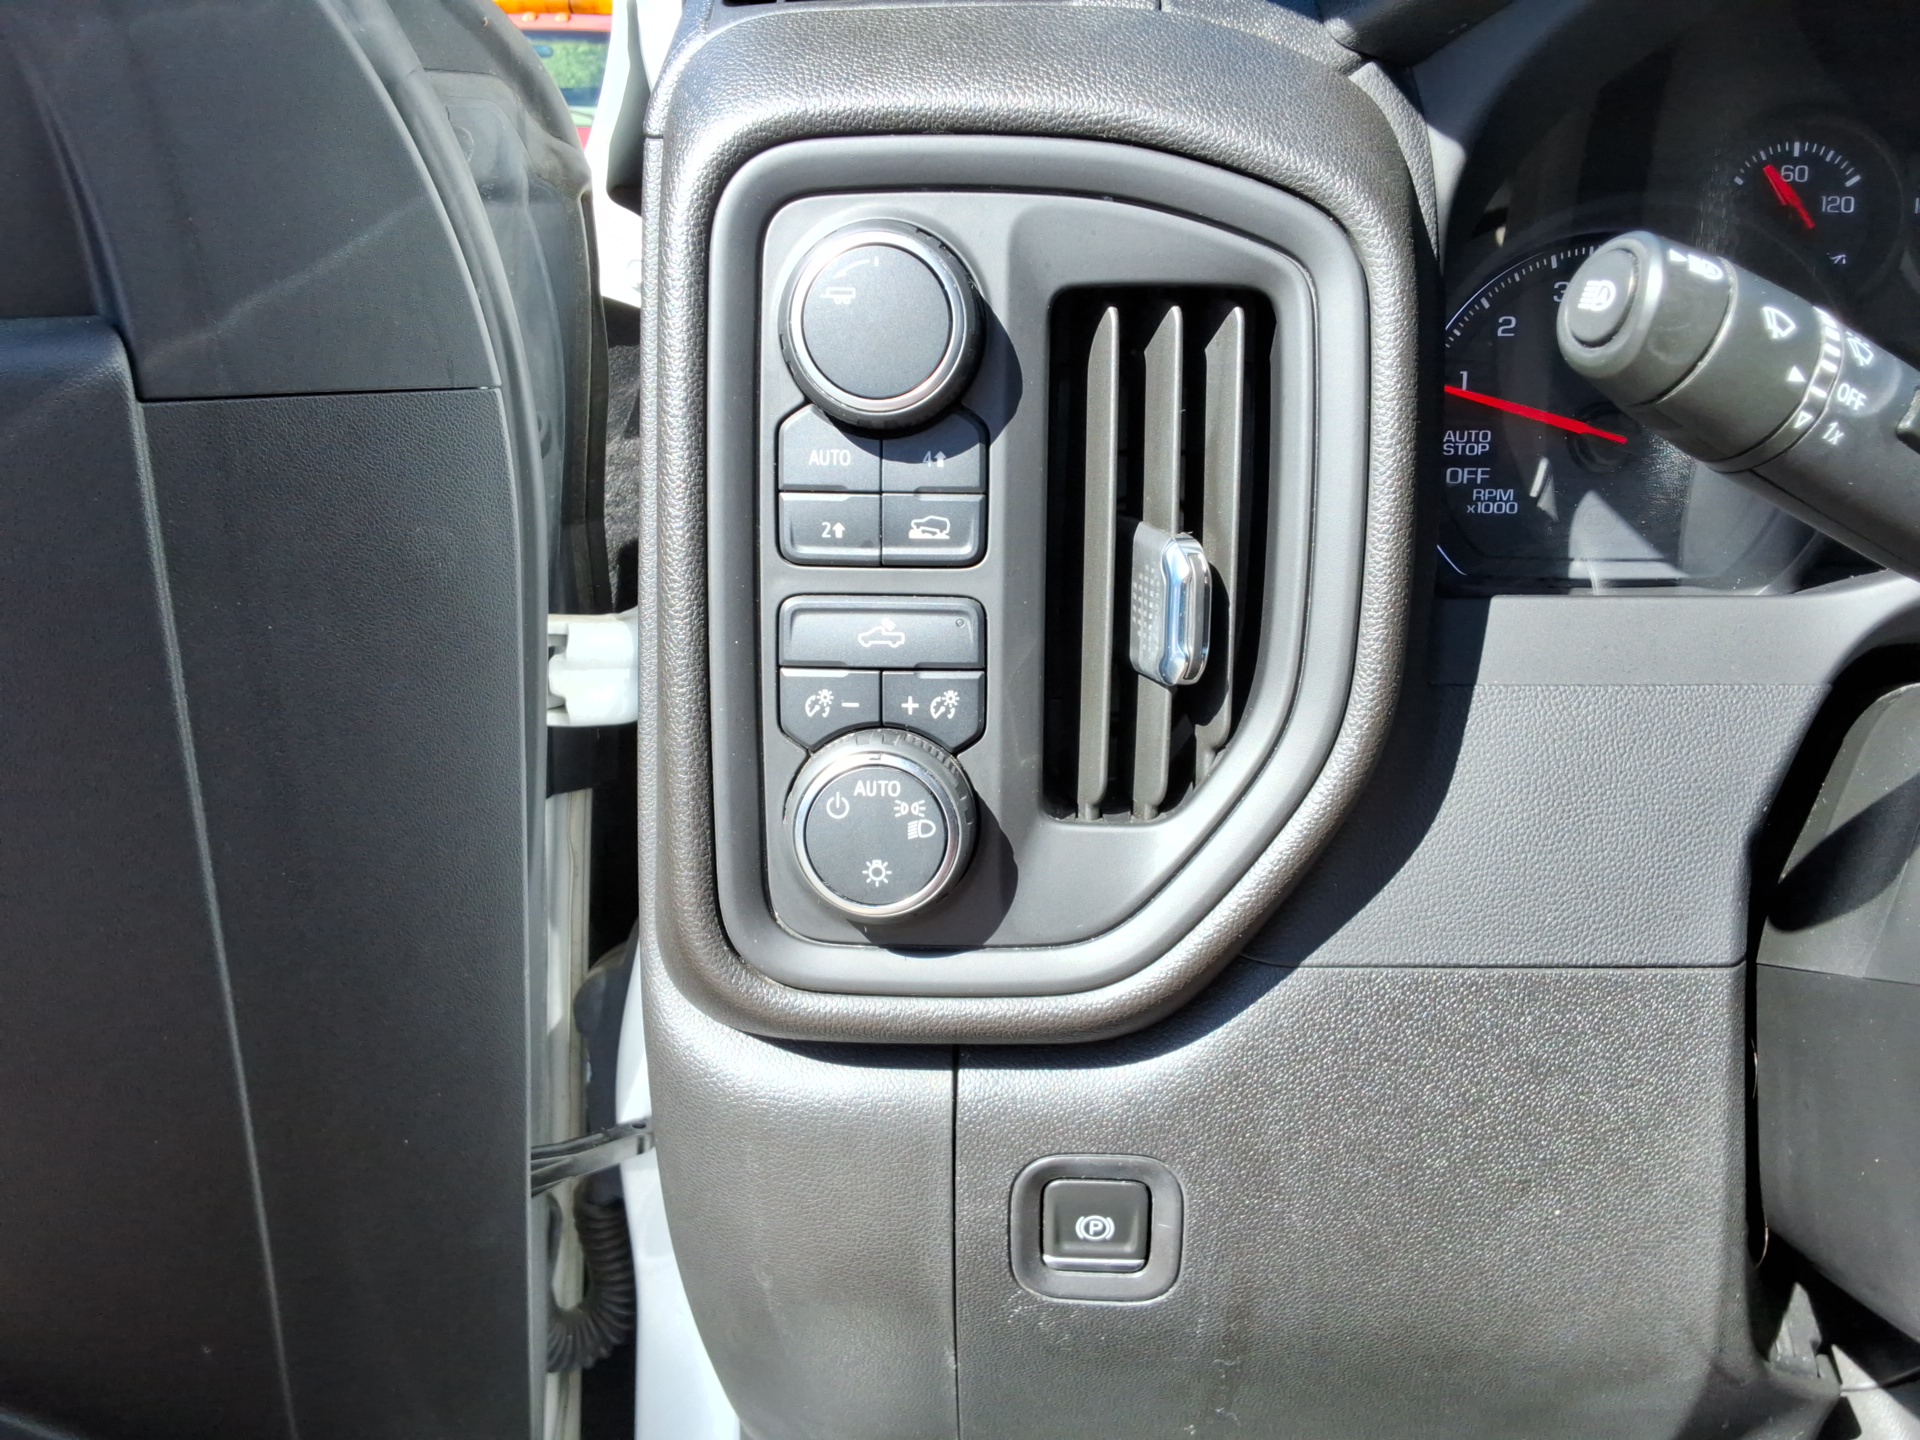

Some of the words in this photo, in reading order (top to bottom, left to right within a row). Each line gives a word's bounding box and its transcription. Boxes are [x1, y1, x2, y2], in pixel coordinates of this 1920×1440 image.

[1780, 165, 1809, 182] 60
[1821, 196, 1855, 213] 120
[1497, 316, 1517, 336] 2
[1459, 370, 1468, 390] 1
[1837, 382, 1867, 411] OFF
[1443, 430, 1491, 442] AUTO
[1822, 421, 1845, 446] 1x
[1443, 443, 1490, 455] STOP
[808, 449, 851, 467] AUTO
[922, 451, 932, 467] 4
[1446, 467, 1491, 484] OFF
[1472, 489, 1514, 501] RPM
[1466, 501, 1518, 514] x1000
[821, 522, 832, 538] 2
[853, 780, 901, 797] AUTO
[1088, 1220, 1104, 1236] P
